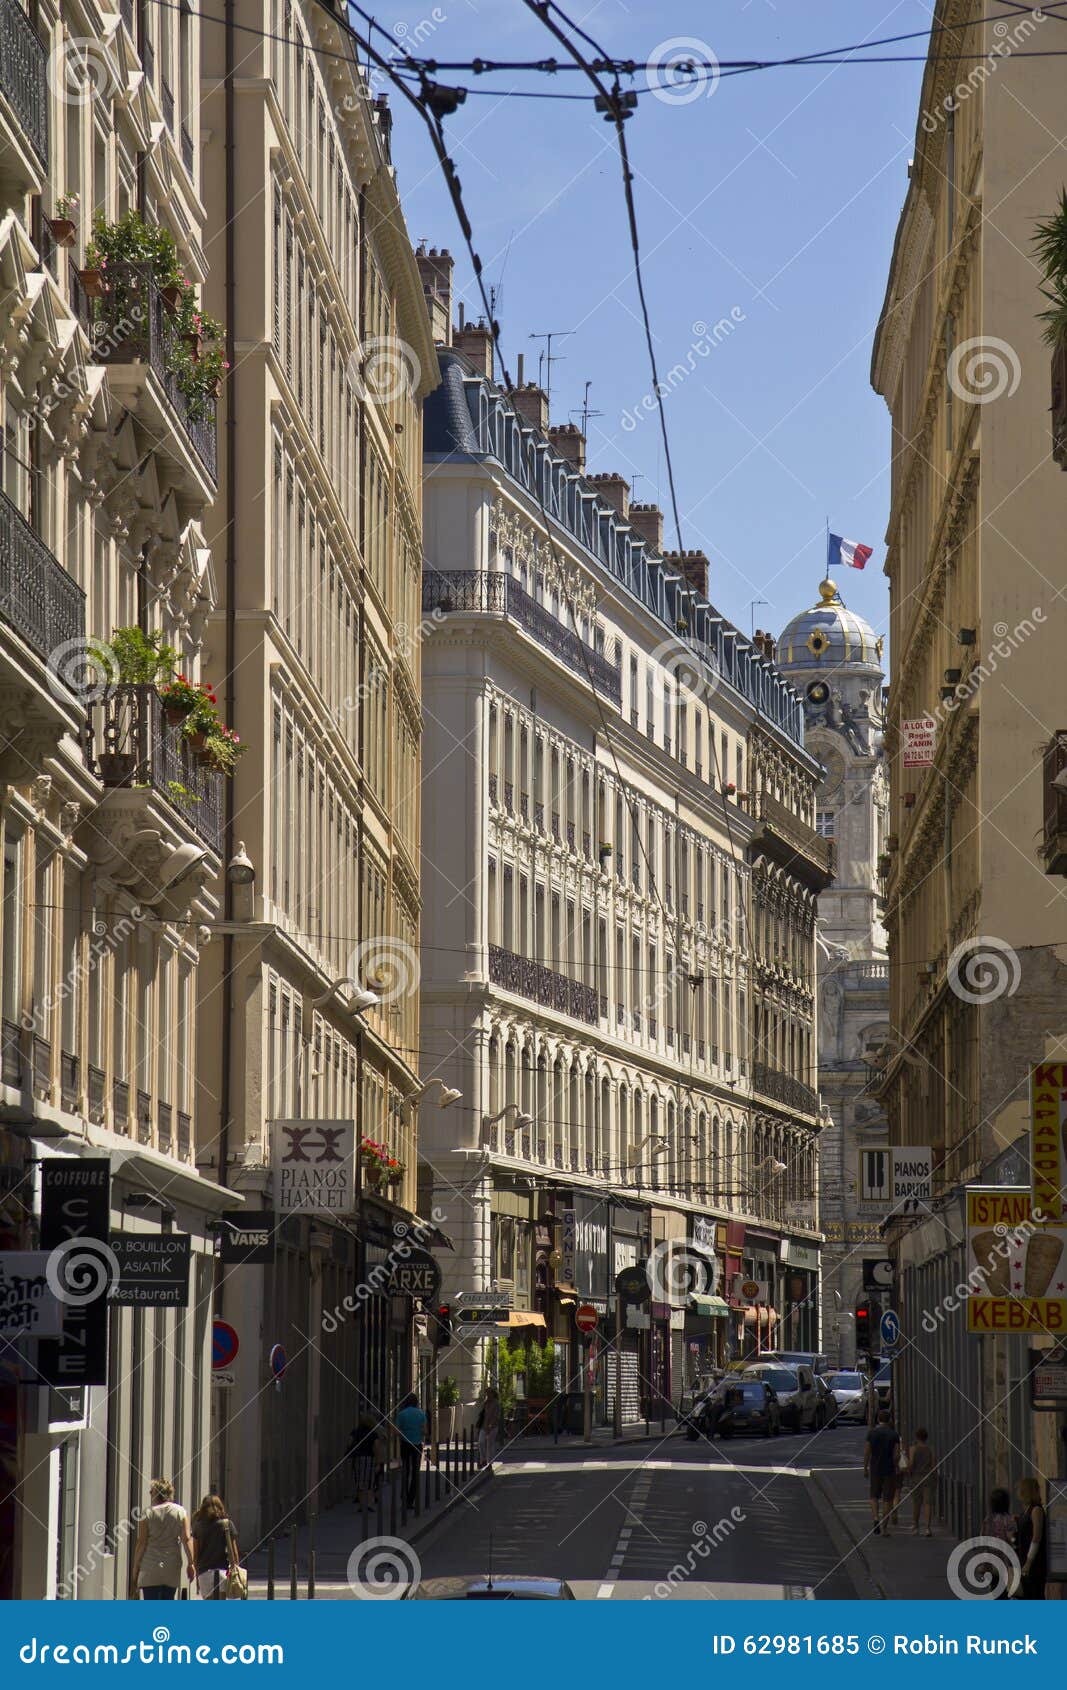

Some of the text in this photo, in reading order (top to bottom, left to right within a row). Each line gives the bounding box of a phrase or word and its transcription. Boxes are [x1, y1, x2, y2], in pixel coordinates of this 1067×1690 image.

[894, 1162, 929, 1177] PIANOS
[46, 1170, 105, 1185] COIFFURE
[280, 1168, 347, 1188] PIANOS
[894, 1182, 930, 1197] BARUTH
[280, 1189, 346, 1208] HANLET
[229, 1231, 269, 1246] VANS
[563, 1212, 574, 1280] GANTS
[126, 1241, 186, 1253] BOUILLON
[123, 1257, 172, 1273] ASIATIK
[57, 1198, 89, 1373] CYENE
[111, 1287, 180, 1300] Restaurant
[972, 1301, 1063, 1329] KEBAB
